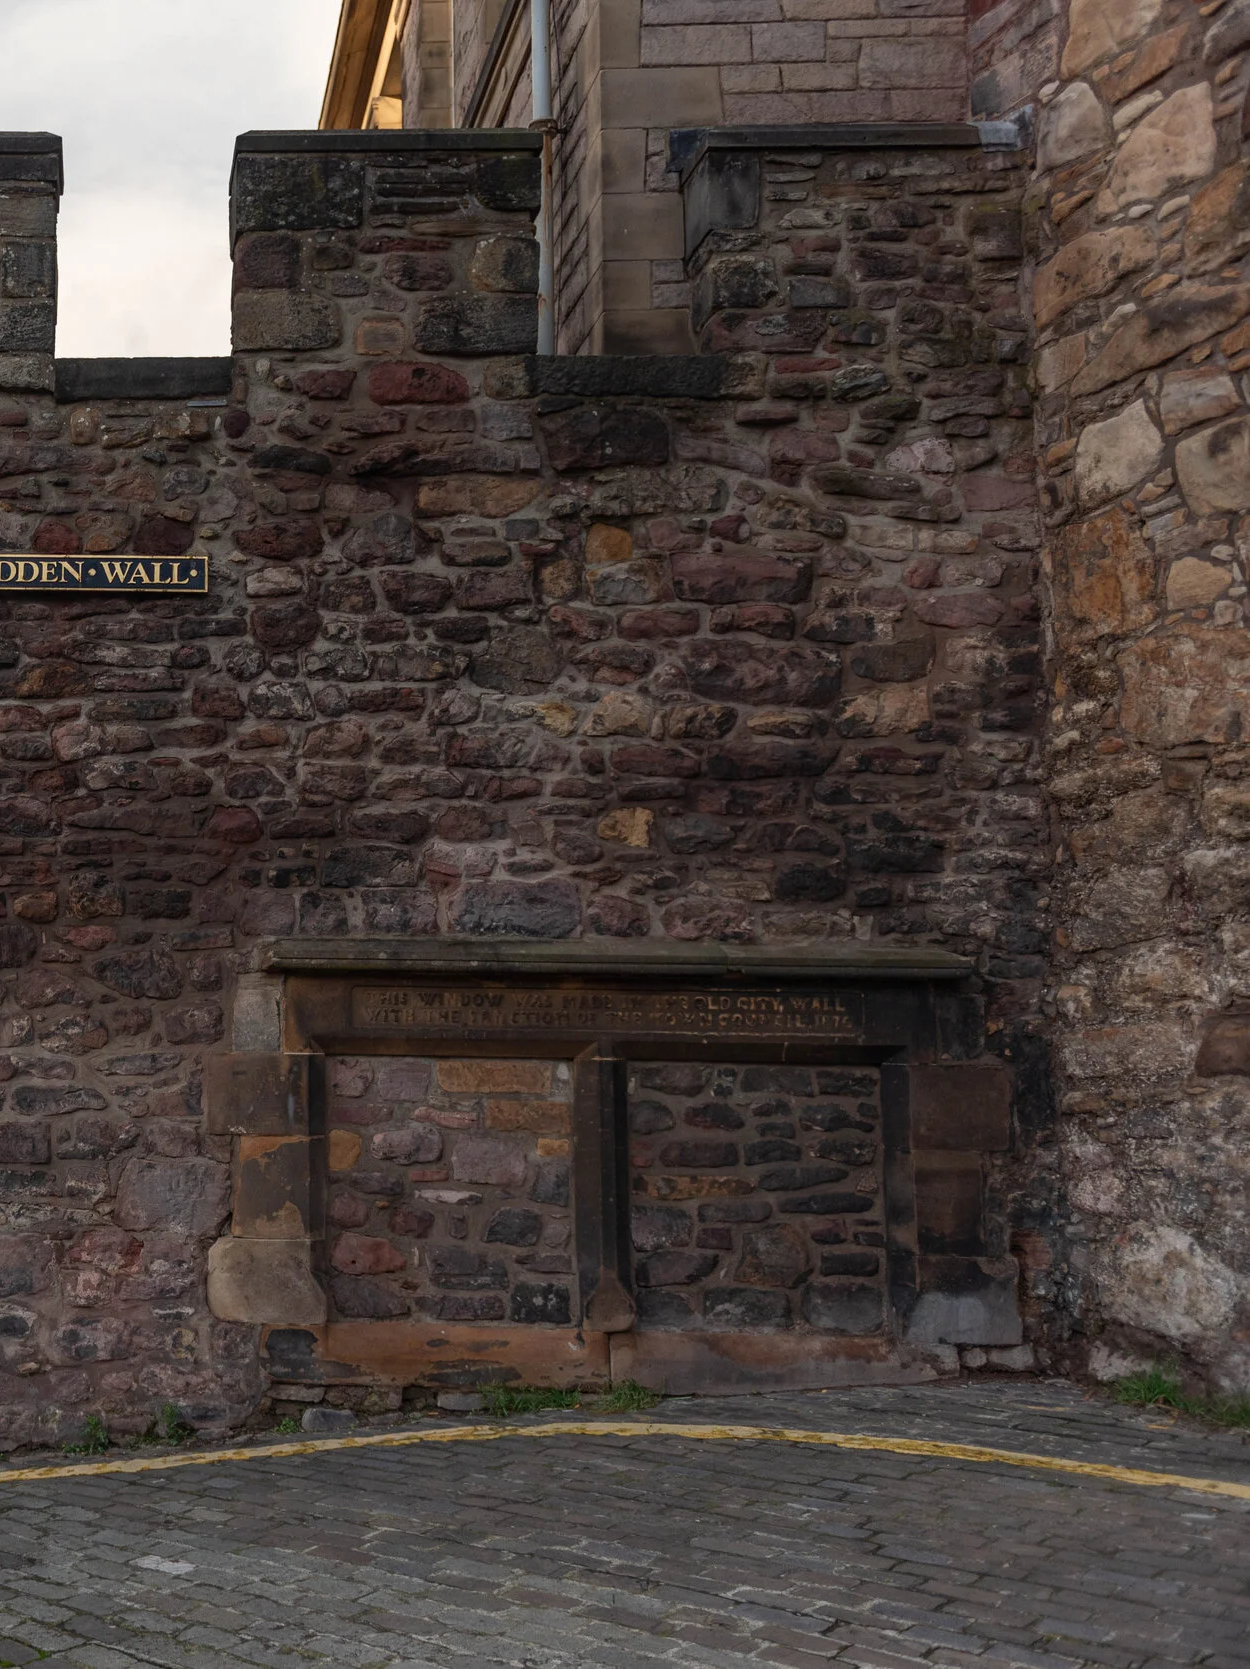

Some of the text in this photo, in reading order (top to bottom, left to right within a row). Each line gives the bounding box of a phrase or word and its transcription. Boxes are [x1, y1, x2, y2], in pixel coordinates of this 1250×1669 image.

[99, 561, 190, 585] WALL
[417, 991, 504, 1007] WINDOW
[512, 992, 553, 1008] WAS
[561, 994, 612, 1009] MADE
[693, 996, 731, 1011] OLD
[789, 997, 846, 1012] WALL
[365, 1008, 415, 1024] WITH
